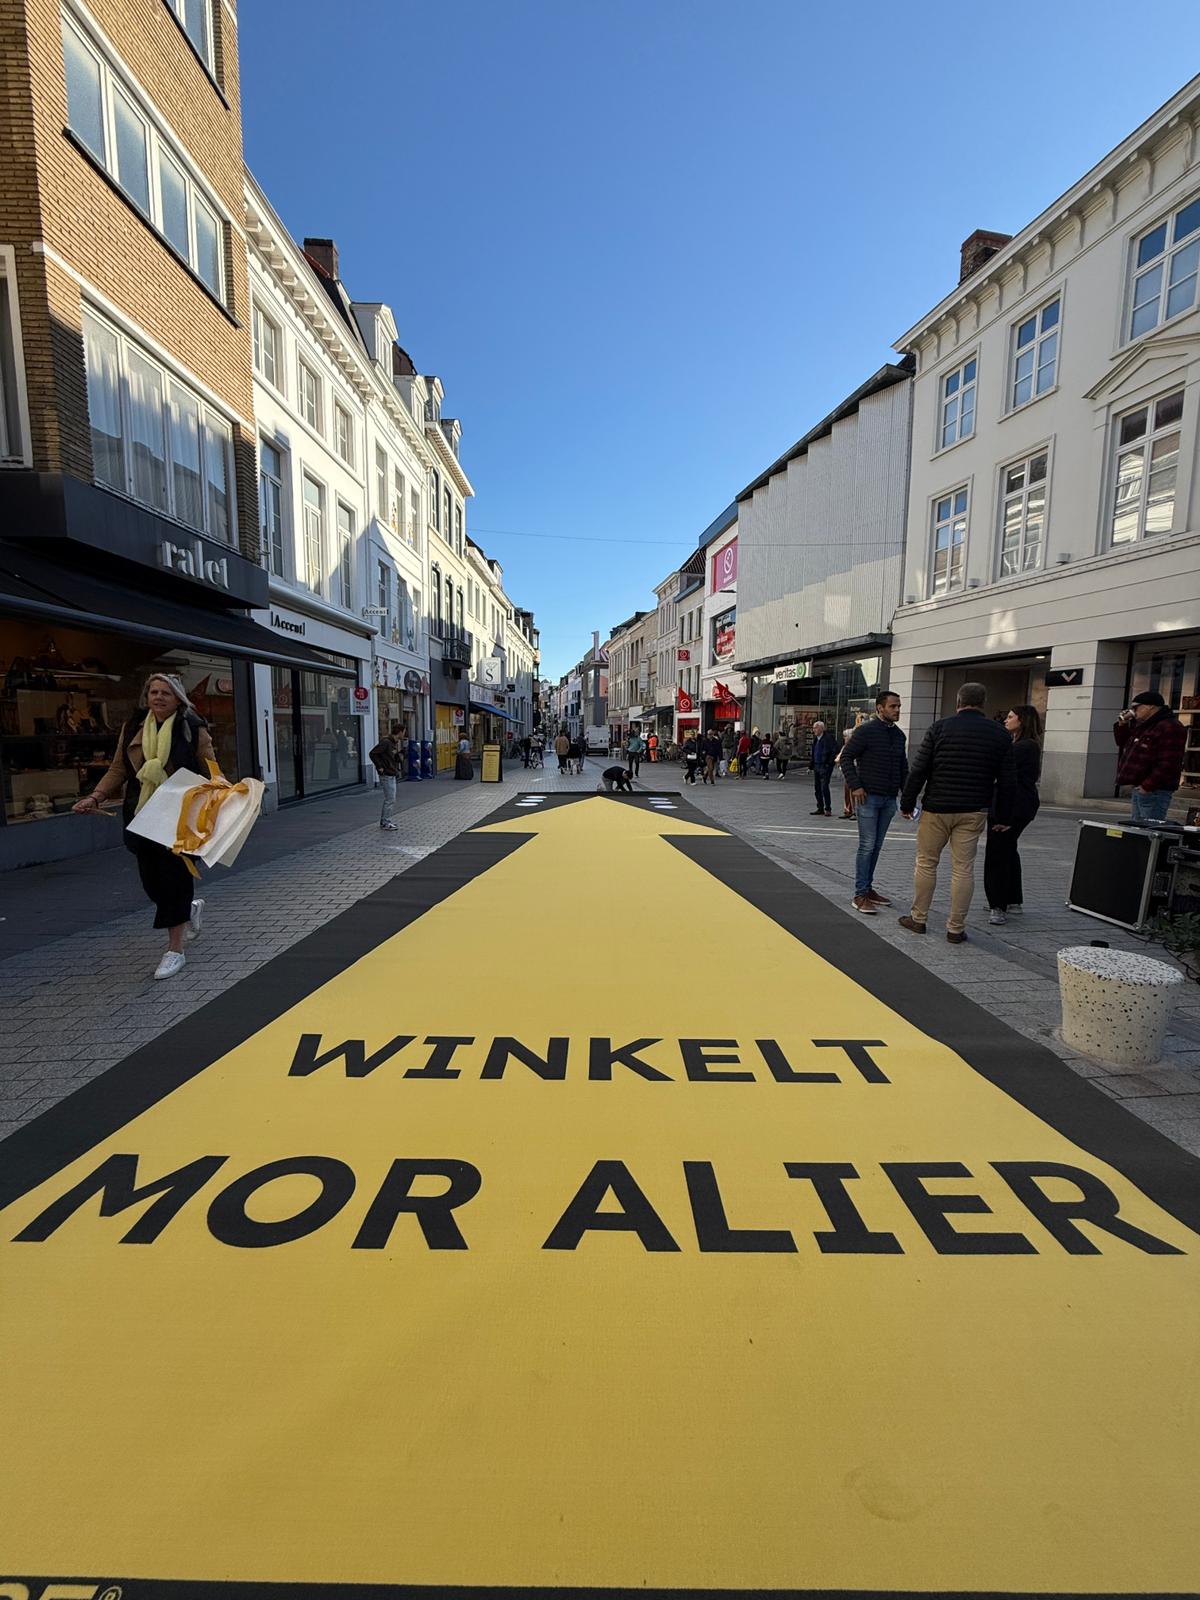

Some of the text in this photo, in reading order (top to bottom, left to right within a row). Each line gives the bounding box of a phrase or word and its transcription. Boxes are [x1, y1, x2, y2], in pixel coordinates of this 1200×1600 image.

[161, 540, 229, 590] ralet
[288, 1034, 892, 1084] WINKELT
[11, 1153, 1188, 1255] MOR ALIER
